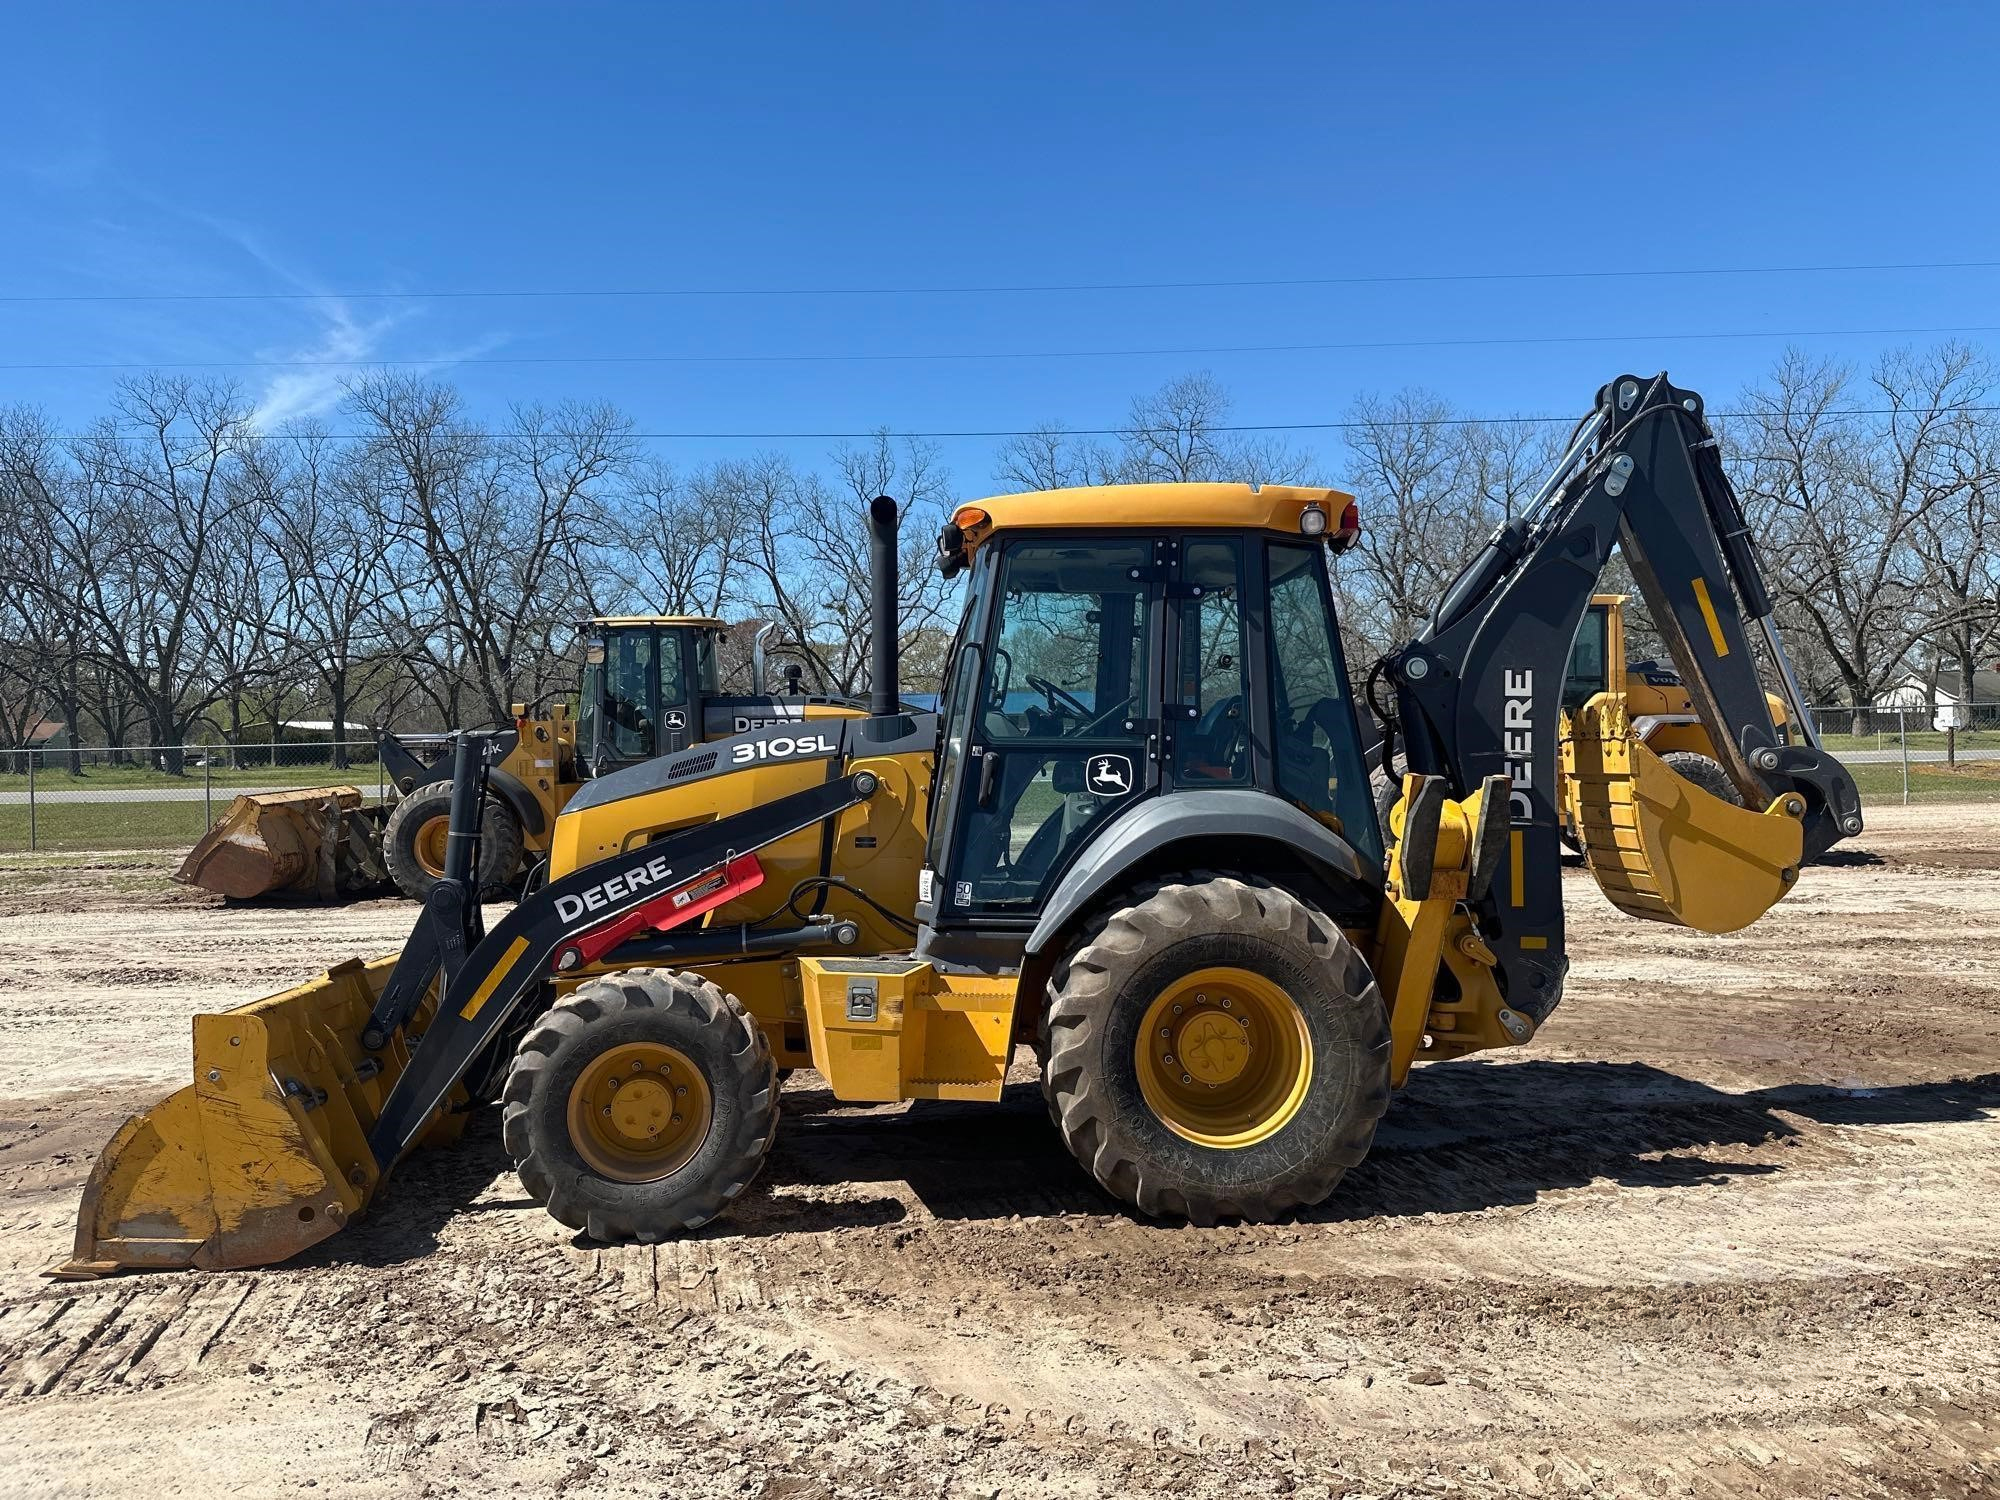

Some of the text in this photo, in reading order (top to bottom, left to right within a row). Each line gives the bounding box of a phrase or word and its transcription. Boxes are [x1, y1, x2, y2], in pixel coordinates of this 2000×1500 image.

[732, 735, 836, 763] 310SL
[1504, 669, 1533, 825] DEERE
[553, 855, 673, 924] DEERE
[957, 883, 971, 894] 50
